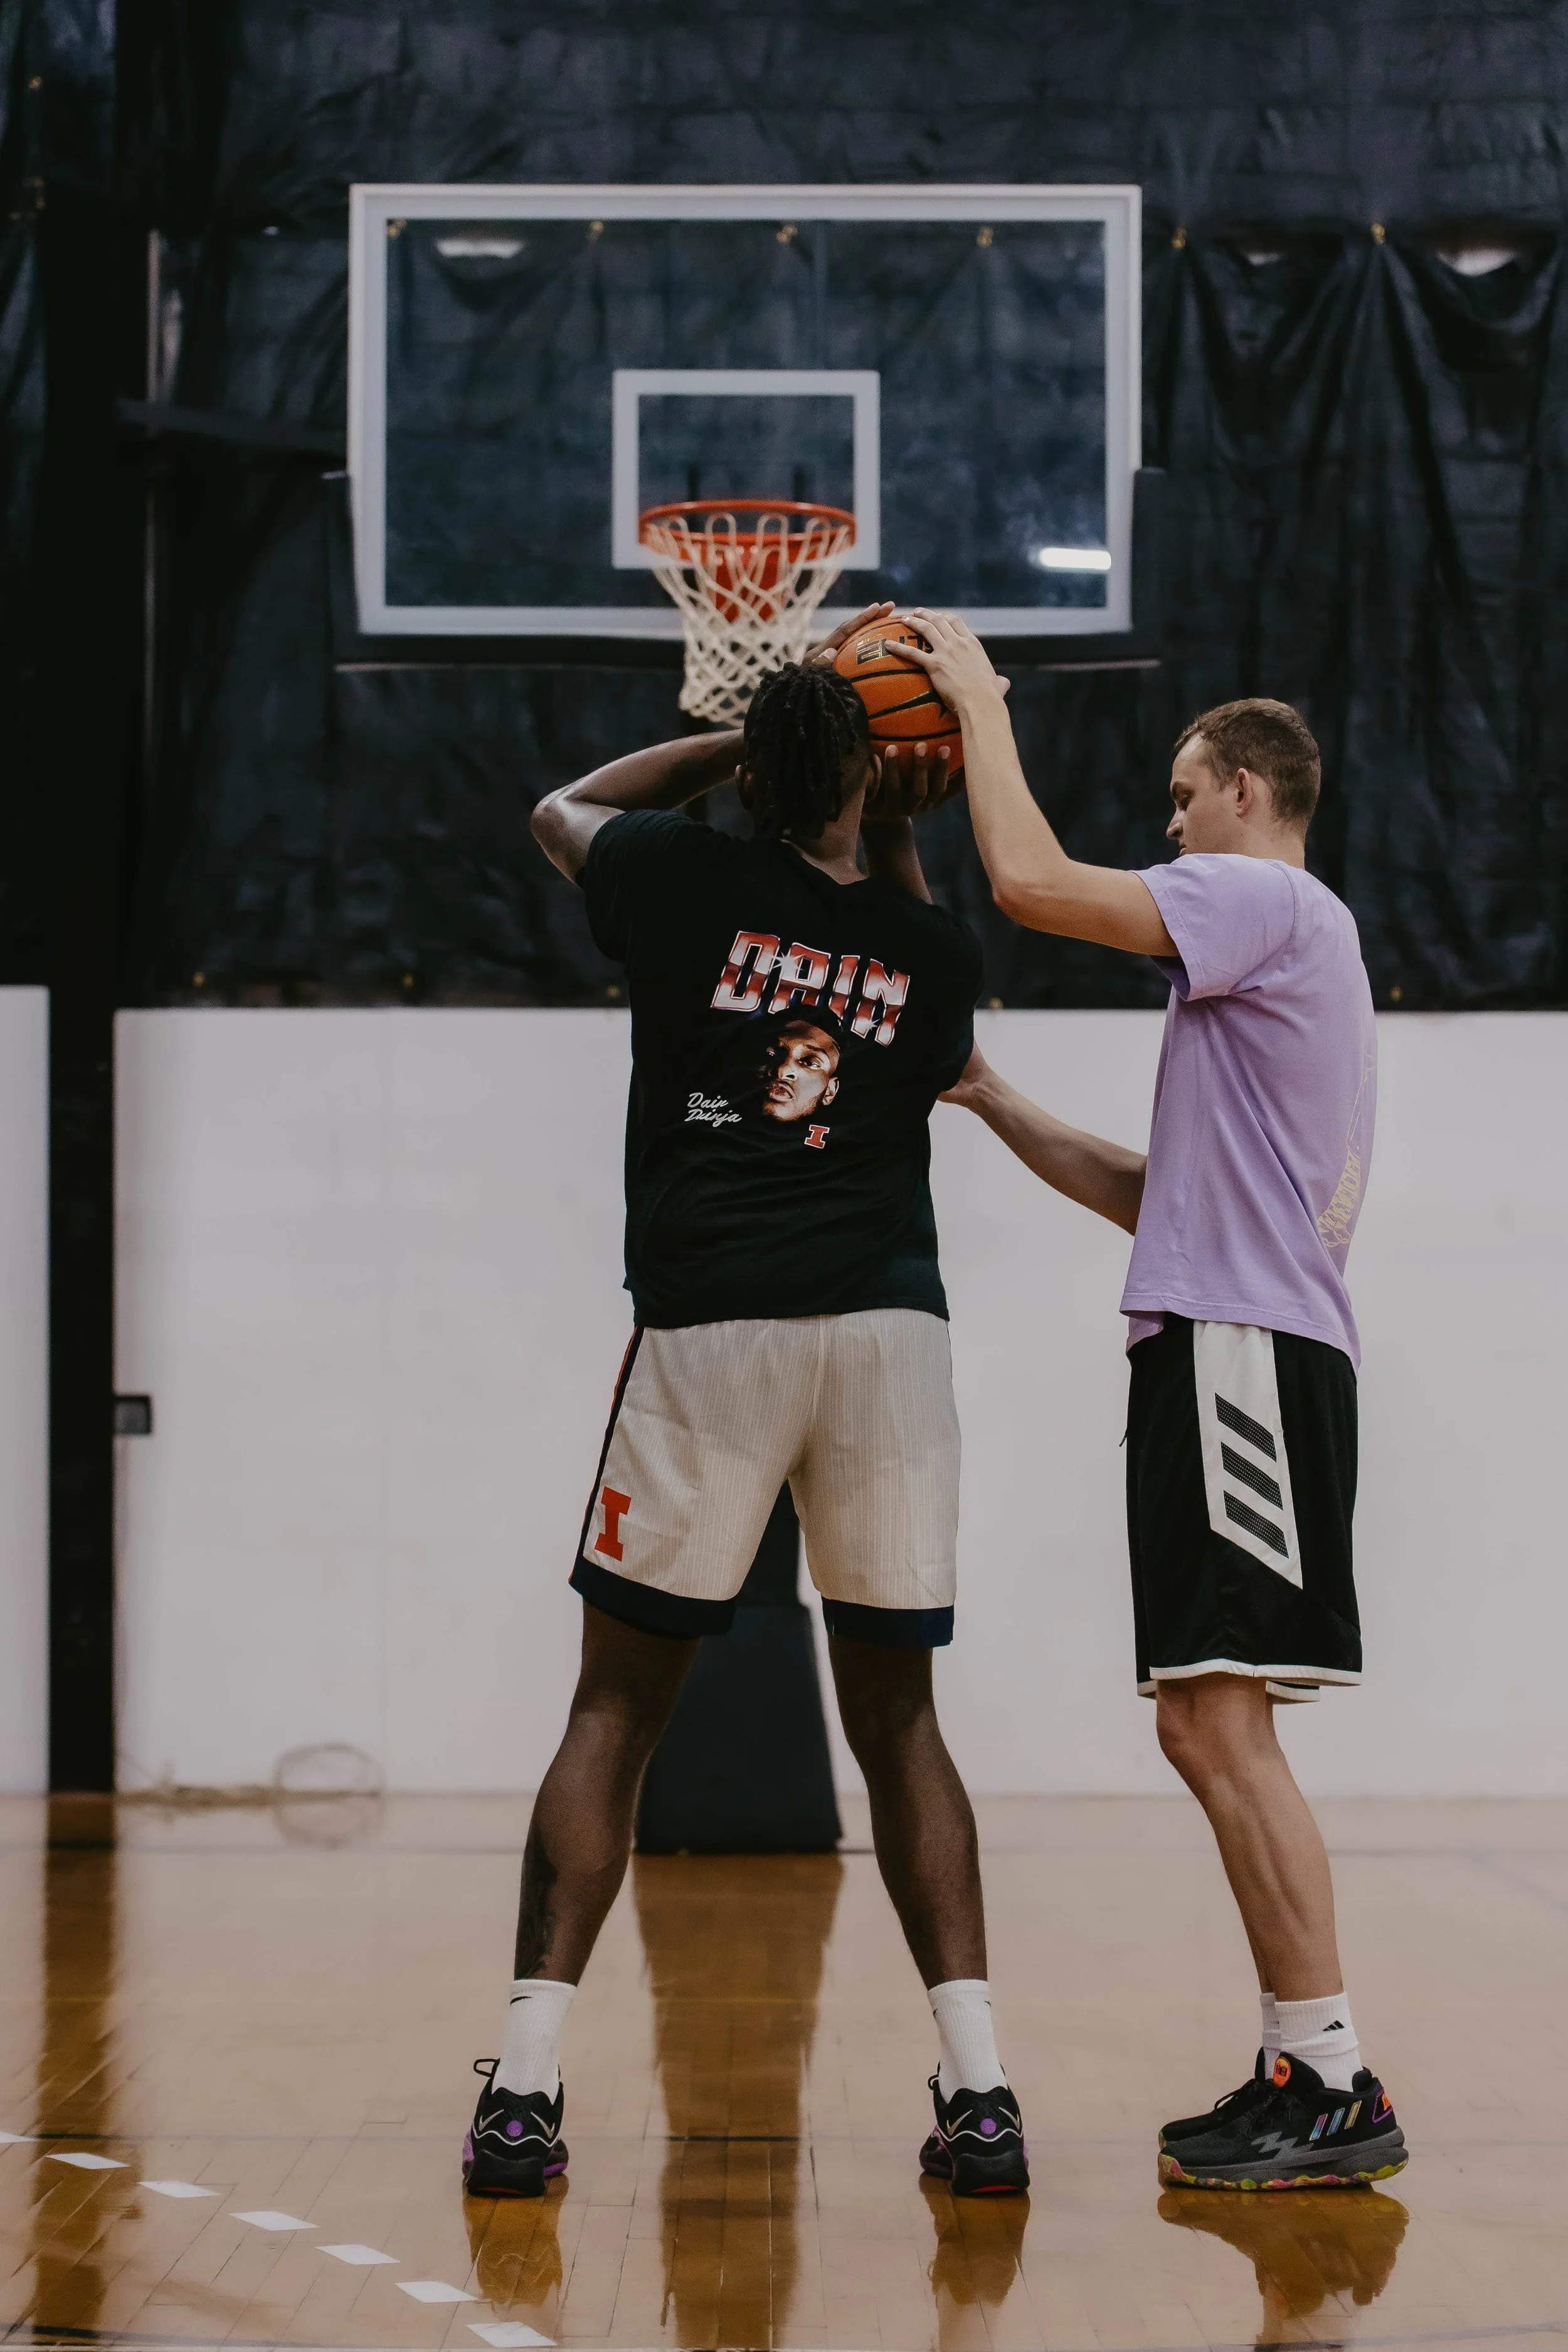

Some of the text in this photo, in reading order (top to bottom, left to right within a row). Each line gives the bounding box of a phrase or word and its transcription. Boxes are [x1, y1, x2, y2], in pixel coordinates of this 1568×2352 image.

[711, 930, 910, 1047] DAIN
[687, 1092, 729, 1108] Dain
[804, 1125, 830, 1149] I
[594, 1486, 632, 1562] I
